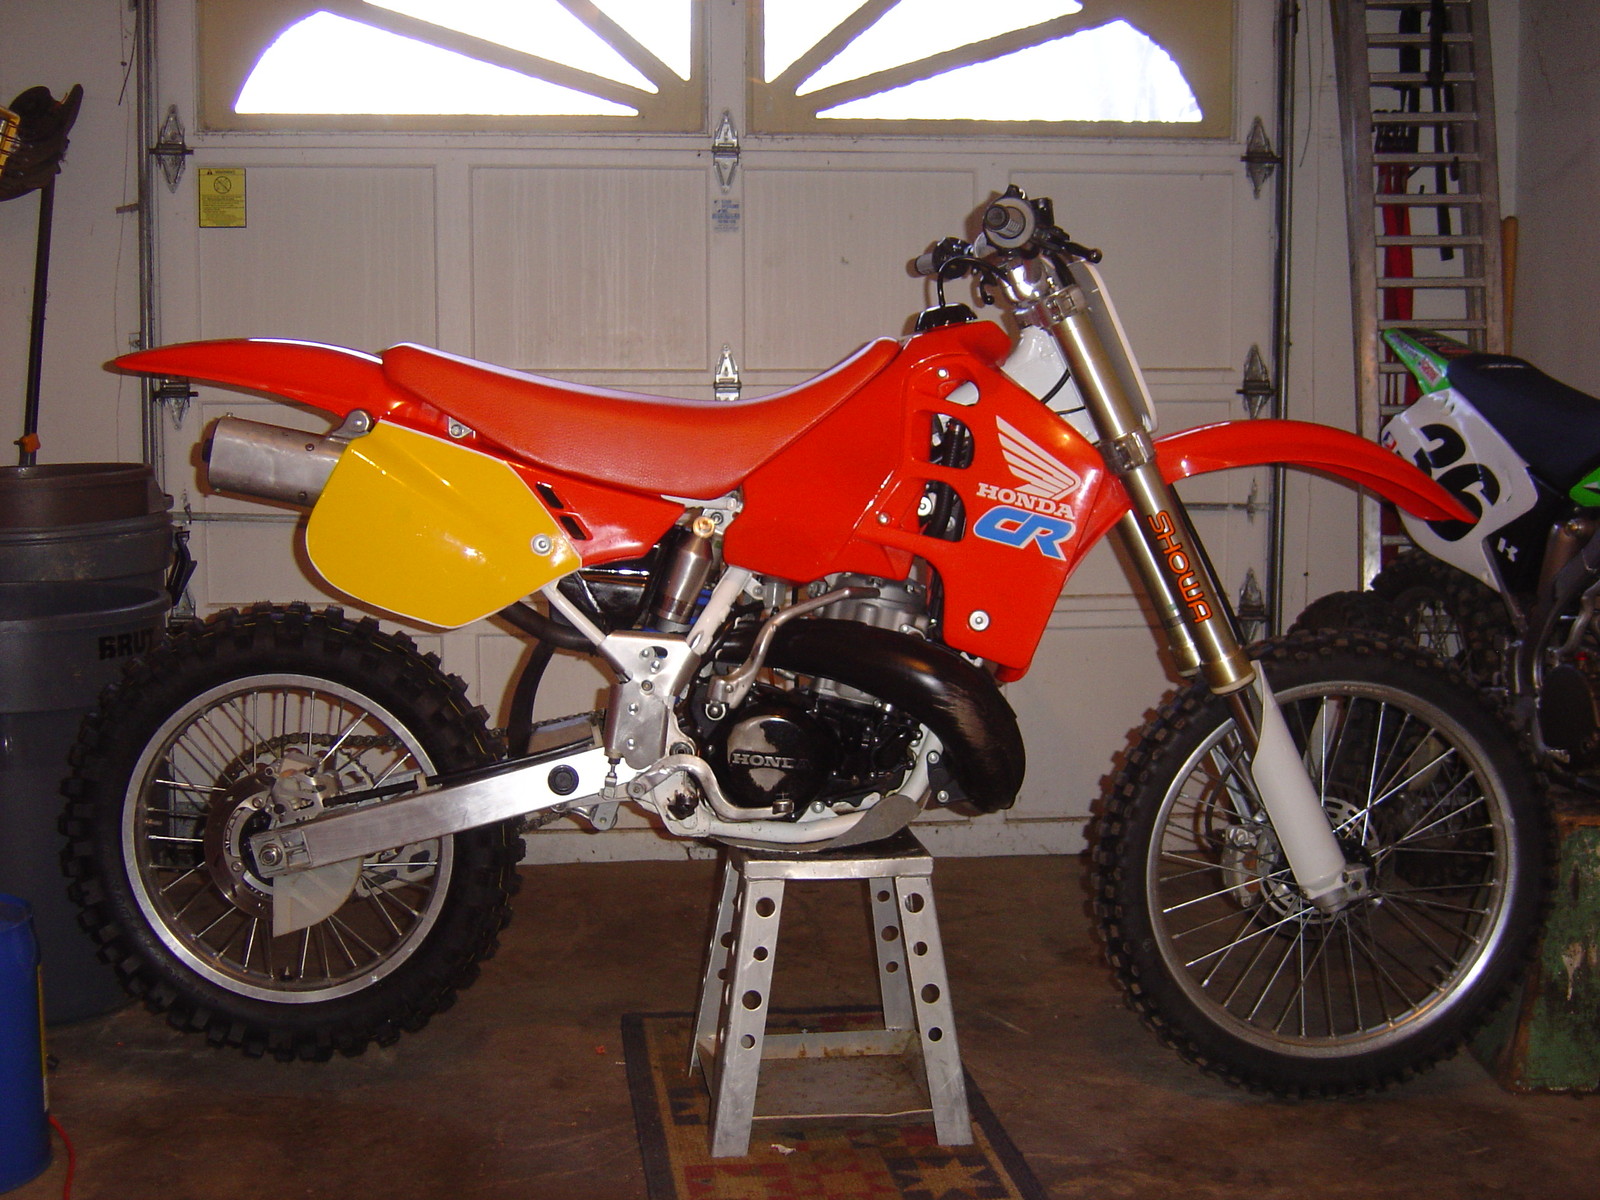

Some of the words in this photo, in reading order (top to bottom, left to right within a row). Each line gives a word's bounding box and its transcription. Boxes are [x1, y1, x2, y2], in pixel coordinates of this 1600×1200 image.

[976, 482, 1075, 520] HONDA
[973, 505, 1076, 561] CR
[1147, 510, 1213, 623] SHOWA
